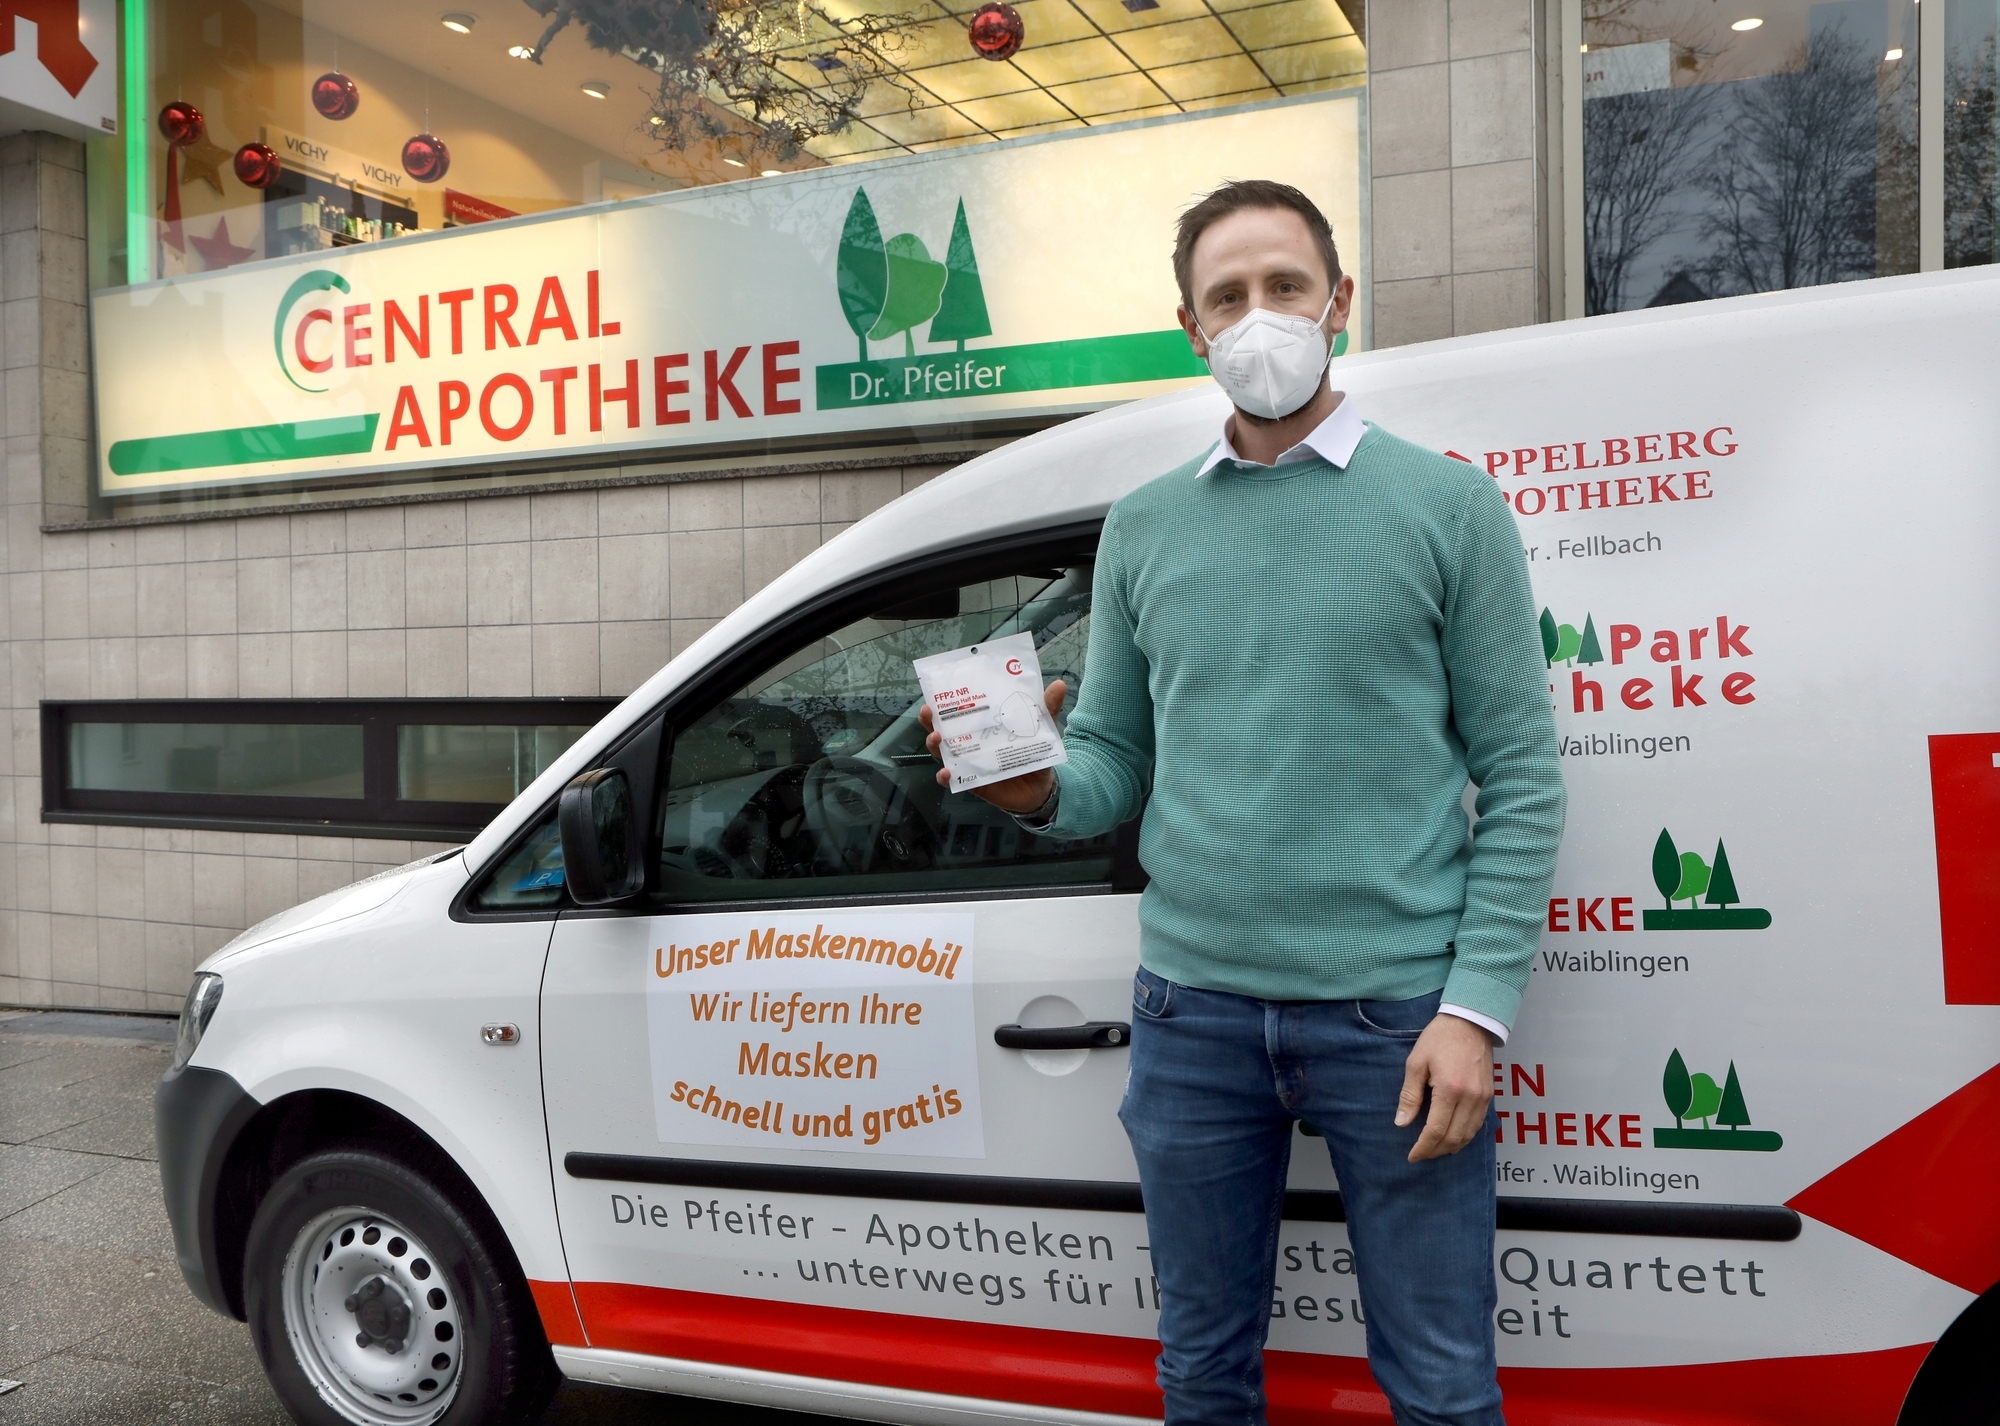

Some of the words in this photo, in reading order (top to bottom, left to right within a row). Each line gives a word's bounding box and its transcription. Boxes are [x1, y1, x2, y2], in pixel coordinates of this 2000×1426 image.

[285, 135, 328, 161] VICHY
[362, 163, 401, 187] VICHY
[294, 269, 621, 374] CENTRAL
[385, 340, 801, 451] APOTHEKE
[850, 371, 889, 401] Dr.
[904, 360, 1006, 396] Pfeifer
[1484, 426, 1739, 478] PPELBERG
[1558, 531, 1662, 559] Fellbach
[1610, 615, 1754, 665] Park
[934, 691, 955, 702] FFP2
[956, 687, 970, 697] NR
[937, 700, 960, 709] Filtering
[1550, 665, 1757, 713] heke
[959, 734, 972, 742] 2163
[535, 872, 551, 884] P
[1548, 896, 1634, 932] EKE
[655, 937, 740, 978] Unser
[746, 924, 963, 980] Maskenmobil
[1543, 950, 1689, 977] Waiblingen
[690, 991, 742, 1023] Wir
[750, 991, 849, 1033] liefern
[859, 993, 922, 1025] Ihre
[738, 1041, 878, 1080] Masken
[669, 1080, 784, 1134] schnell
[792, 1104, 853, 1138] und
[862, 1084, 962, 1146] gratis
[1495, 1111, 1642, 1148] THEKE
[1496, 1161, 1535, 1183] ifer
[1553, 1164, 1700, 1193] Waiblingen
[611, 1194, 668, 1228] Die
[684, 1200, 814, 1240] Pfeifer
[865, 1213, 1114, 1262] Apotheken
[1284, 1240, 1357, 1275] sta
[1500, 1246, 1767, 1297] Quartett
[798, 1258, 1027, 1306] unterwegs
[1044, 1269, 1114, 1308] für
[1135, 1275, 1161, 1310] Ih
